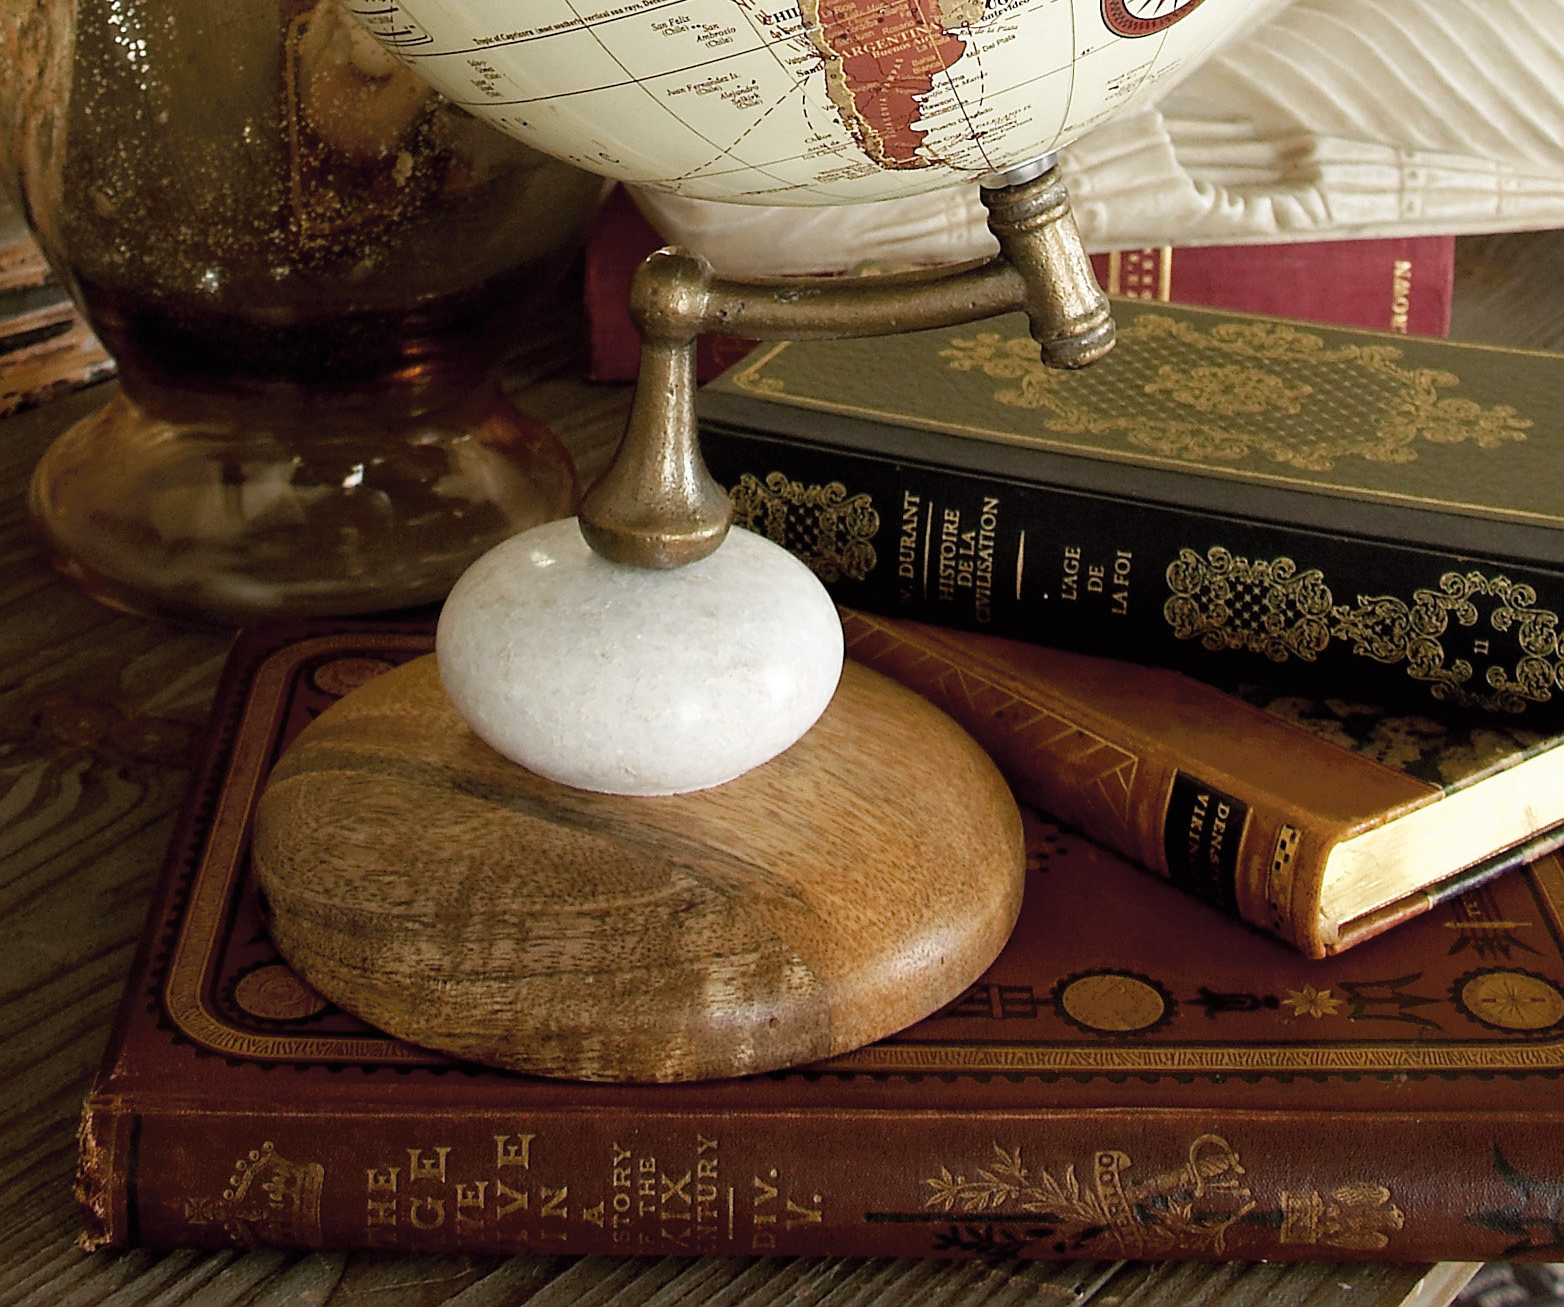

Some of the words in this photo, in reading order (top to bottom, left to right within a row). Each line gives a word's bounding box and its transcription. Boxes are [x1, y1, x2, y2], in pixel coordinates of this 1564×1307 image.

[841, 17, 941, 59] ARGENTINA
[899, 490, 921, 580] DURANT
[938, 507, 961, 602] HISTOIRE
[959, 530, 978, 557] LA
[957, 559, 975, 589] DE
[976, 495, 1001, 624] CIVILISATION
[1061, 546, 1081, 602] L'AGE
[1087, 564, 1105, 594] DE
[1114, 549, 1133, 588] FOI
[1111, 590, 1129, 616] LA
[637, 1155, 657, 1217] THE
[582, 1200, 605, 1228] A
[752, 1167, 781, 1251] DIV.
[786, 1192, 825, 1231] V.
